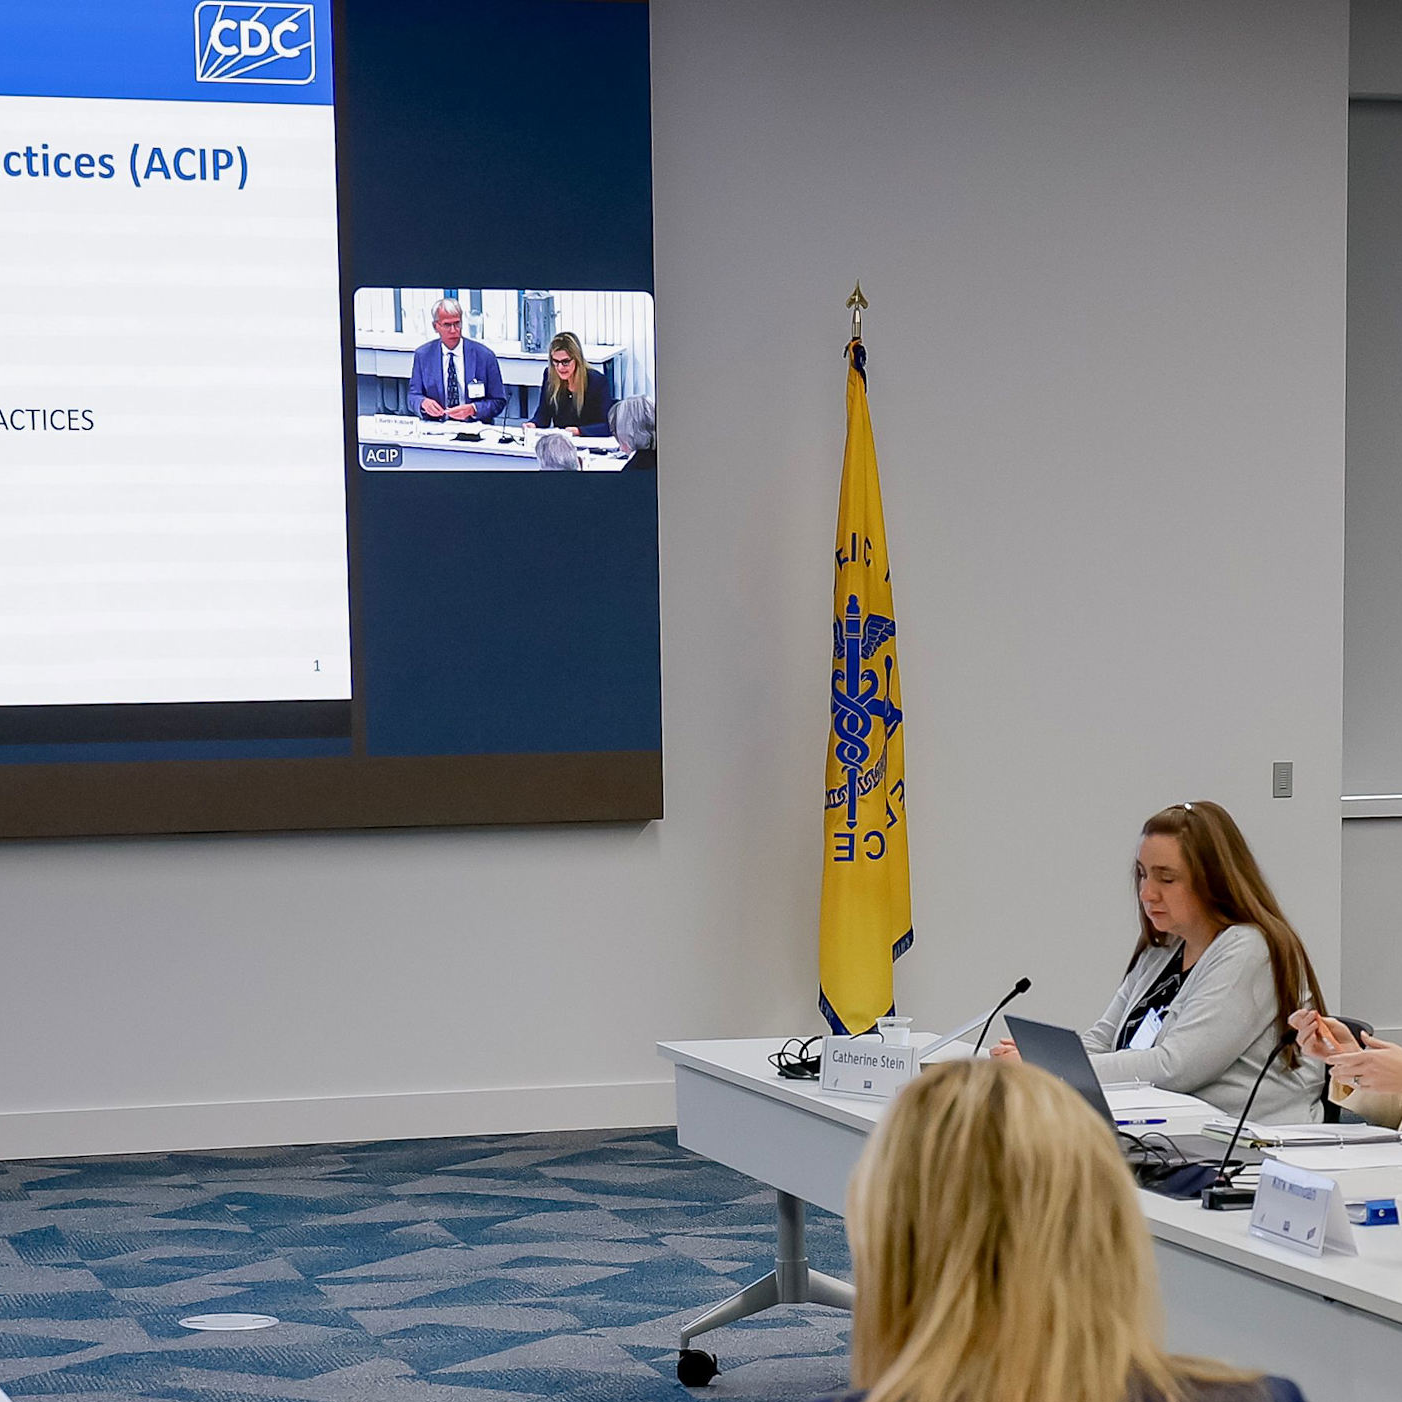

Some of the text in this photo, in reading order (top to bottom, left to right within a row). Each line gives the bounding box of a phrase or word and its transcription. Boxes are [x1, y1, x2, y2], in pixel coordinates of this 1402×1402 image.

[210, 18, 301, 58] CDC
[130, 144, 248, 190] (ACIP)
[366, 449, 399, 463] ACIP
[313, 659, 321, 672] 1
[832, 1049, 905, 1070] Catherine Stein
